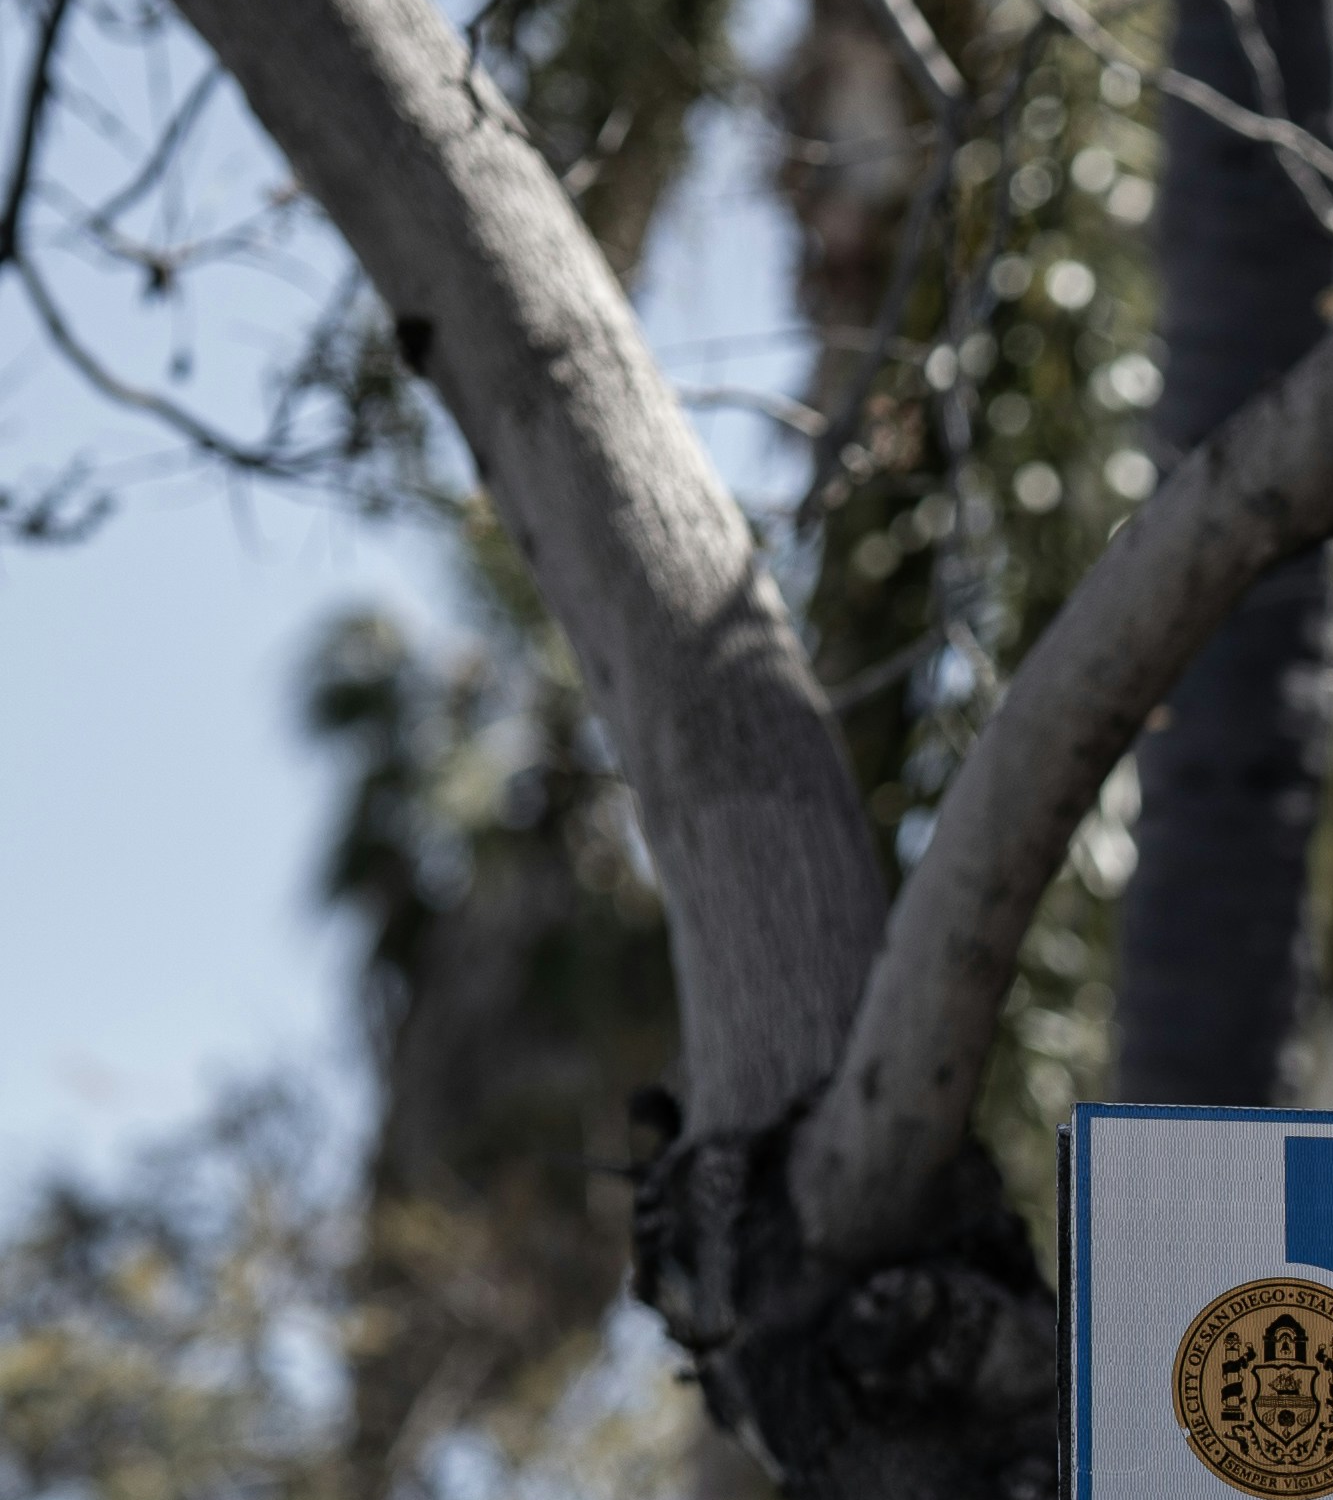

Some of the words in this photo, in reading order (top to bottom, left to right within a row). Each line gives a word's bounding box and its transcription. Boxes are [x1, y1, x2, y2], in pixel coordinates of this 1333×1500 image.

[1229, 1289, 1285, 1317] DIEGO
[1200, 1309, 1231, 1342] SAN
[1187, 1342, 1206, 1367] OF
[1184, 1371, 1200, 1413] CITY
[1190, 1415, 1214, 1452] THE
[1225, 1459, 1278, 1488] SEMPER
